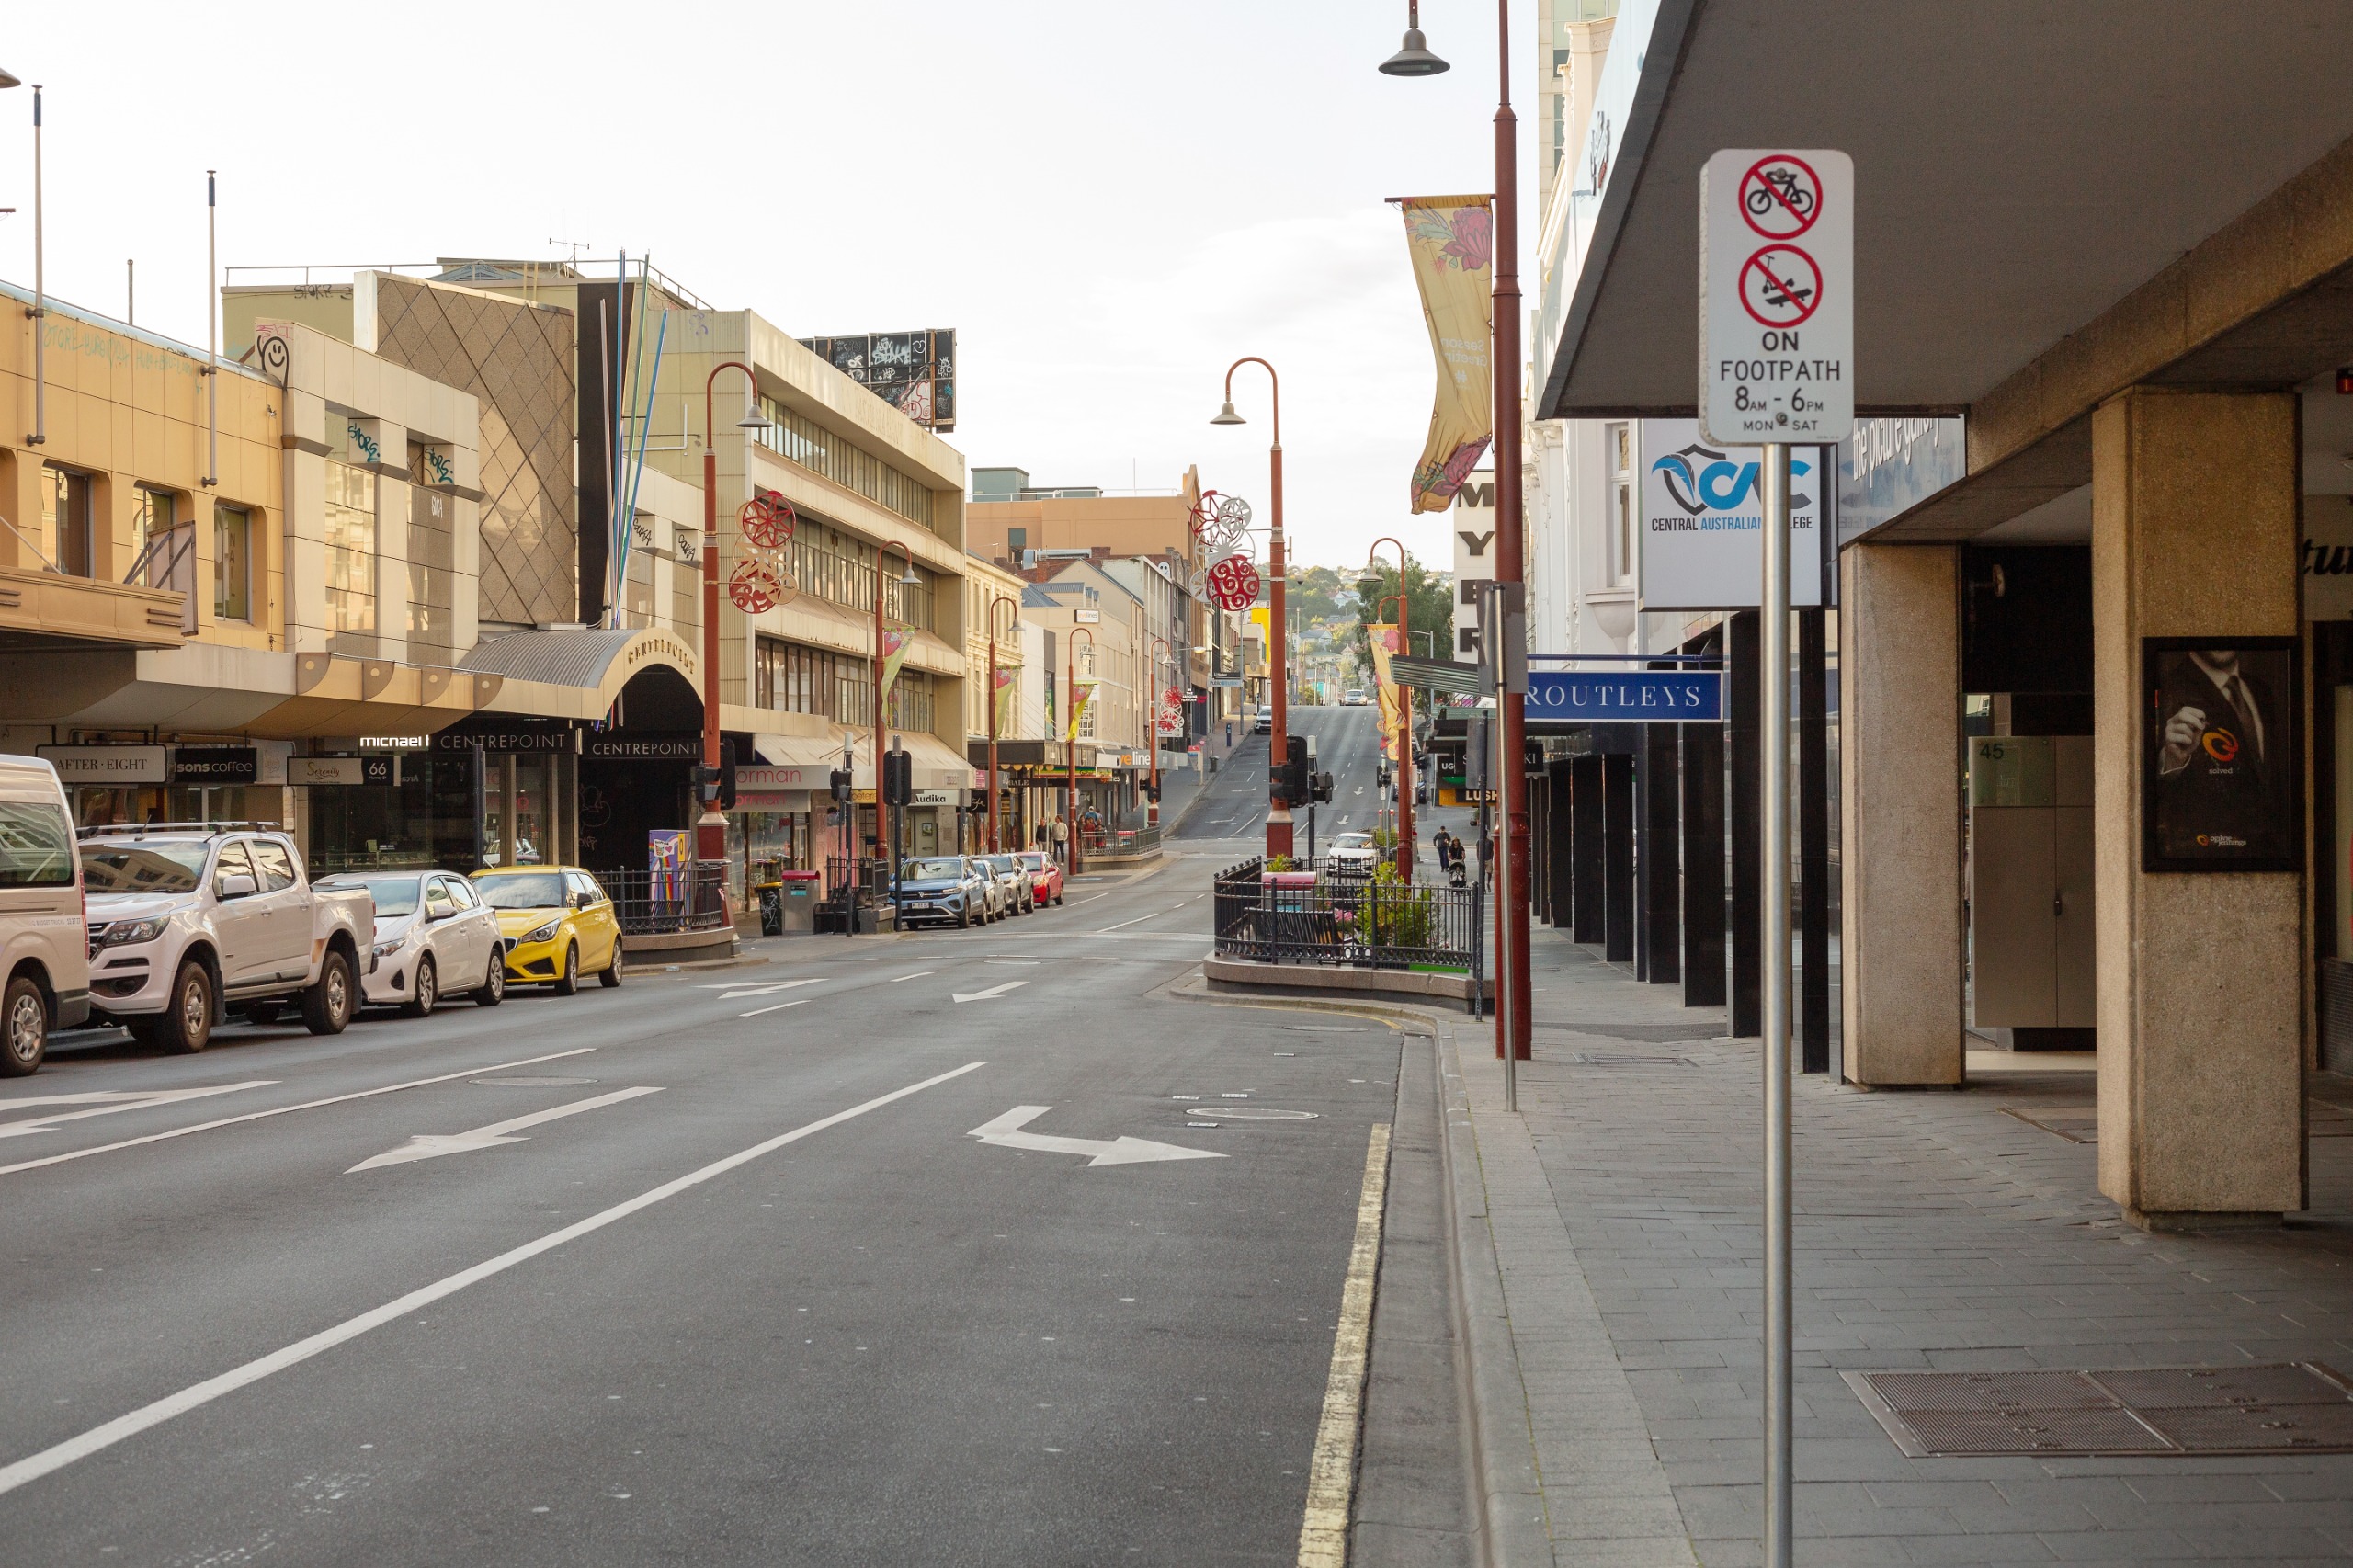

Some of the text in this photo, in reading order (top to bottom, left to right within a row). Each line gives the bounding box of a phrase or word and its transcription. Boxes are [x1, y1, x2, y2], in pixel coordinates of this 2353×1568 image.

[1762, 331, 1799, 351] ON
[1721, 360, 1840, 381] FOOTPATH
[1735, 386, 1767, 411] 8AM
[1791, 387, 1824, 411] 6PM
[1744, 420, 1818, 431] MON SAT
[1652, 517, 1698, 531] CENTRAL
[628, 638, 695, 674] CENTREPOINT
[1525, 686, 1700, 707] ROUTLEYS
[440, 734, 565, 749] CENTREPOINT
[592, 743, 699, 755] CENTREPOINT
[1980, 743, 2004, 759] 45
[57, 759, 147, 770] AFTER EIGHT
[175, 761, 253, 772] sons coffee
[369, 762, 387, 775] 66
[735, 769, 801, 783] orman
[735, 792, 787, 807] orman
